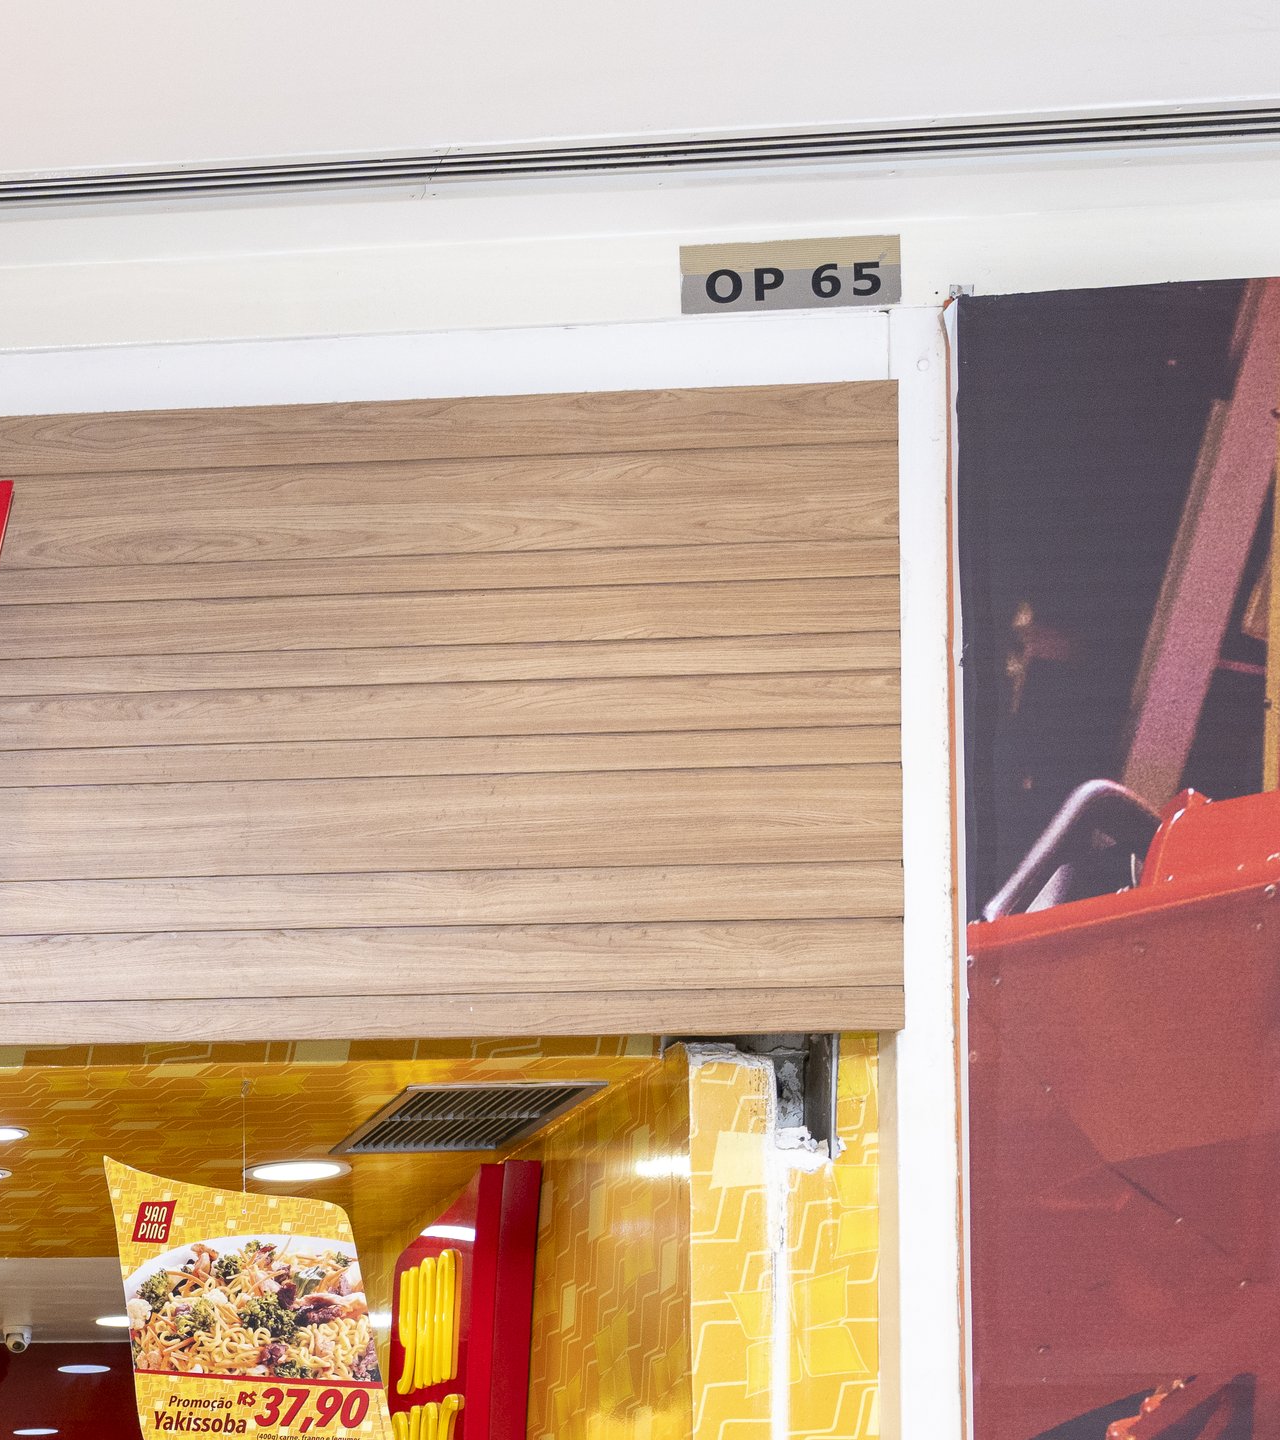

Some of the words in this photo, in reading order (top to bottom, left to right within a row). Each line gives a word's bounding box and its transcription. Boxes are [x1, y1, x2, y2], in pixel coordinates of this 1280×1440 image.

[705, 267, 785, 304] OP
[811, 261, 882, 299] 65
[144, 1205, 168, 1223] YAN
[137, 1222, 167, 1240] PING
[168, 1396, 233, 1411] Promoção
[237, 1391, 257, 1407] R$
[254, 1387, 370, 1433] 37,90
[154, 1411, 247, 1434] Yakissoba
